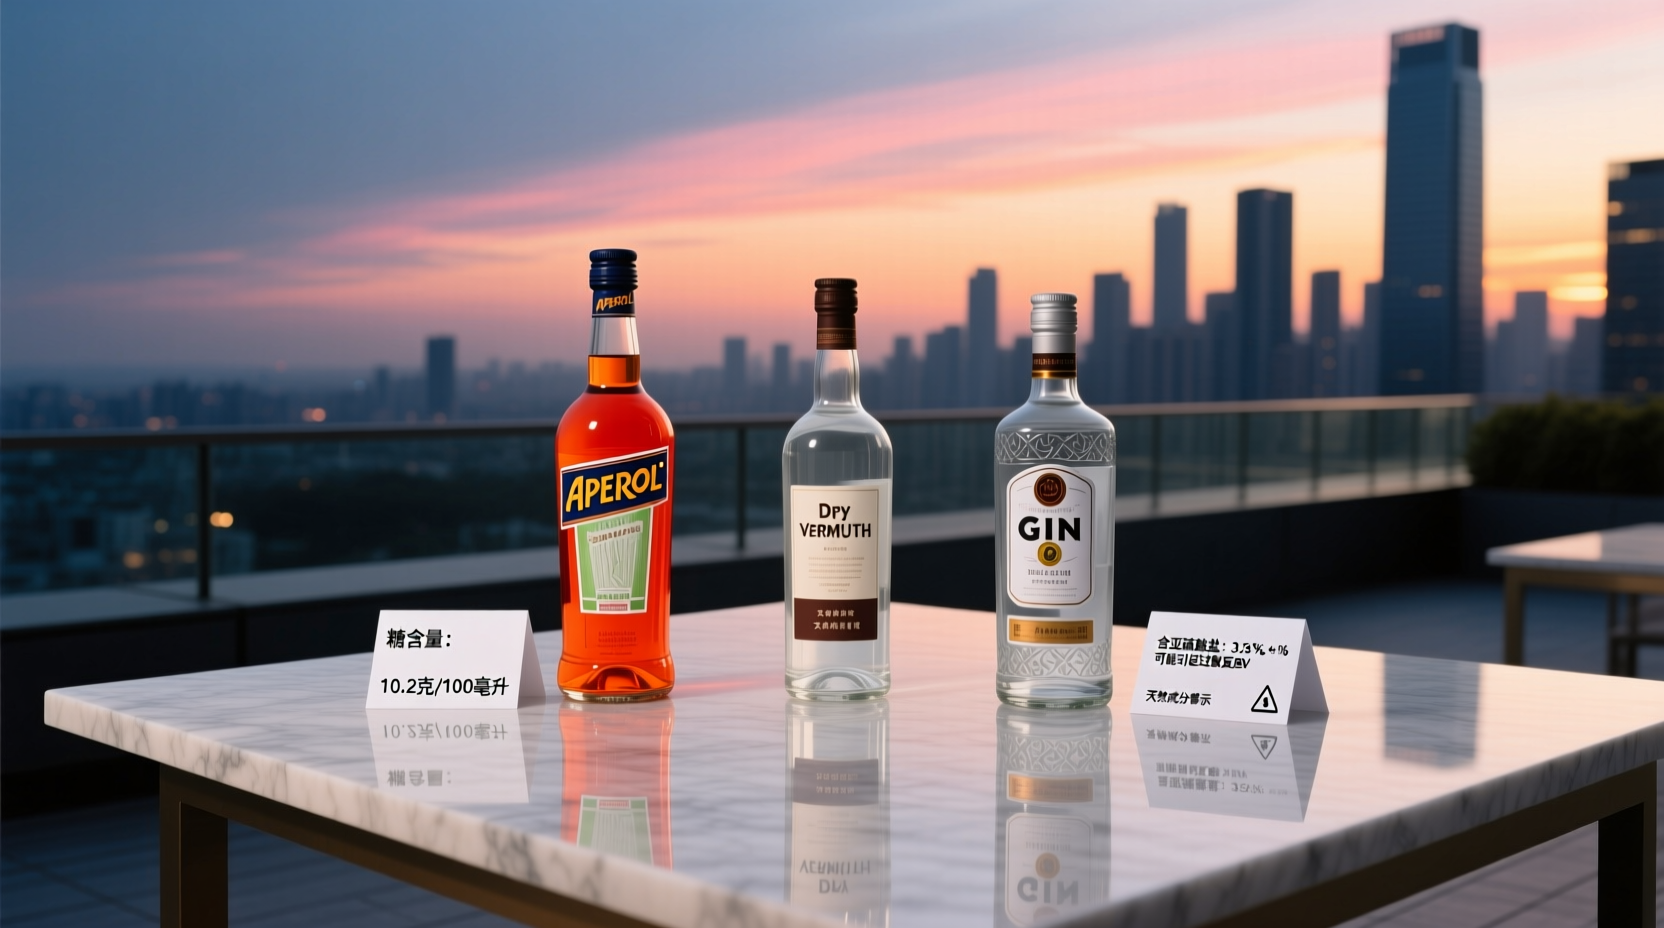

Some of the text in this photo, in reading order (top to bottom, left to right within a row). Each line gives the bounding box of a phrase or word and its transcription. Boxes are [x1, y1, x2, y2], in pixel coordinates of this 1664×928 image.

[565, 463, 663, 513] APEROL
[799, 522, 872, 539] VERMUTH
[1018, 516, 1081, 541] GIN
[380, 675, 510, 697] 10.2克/100毫升
